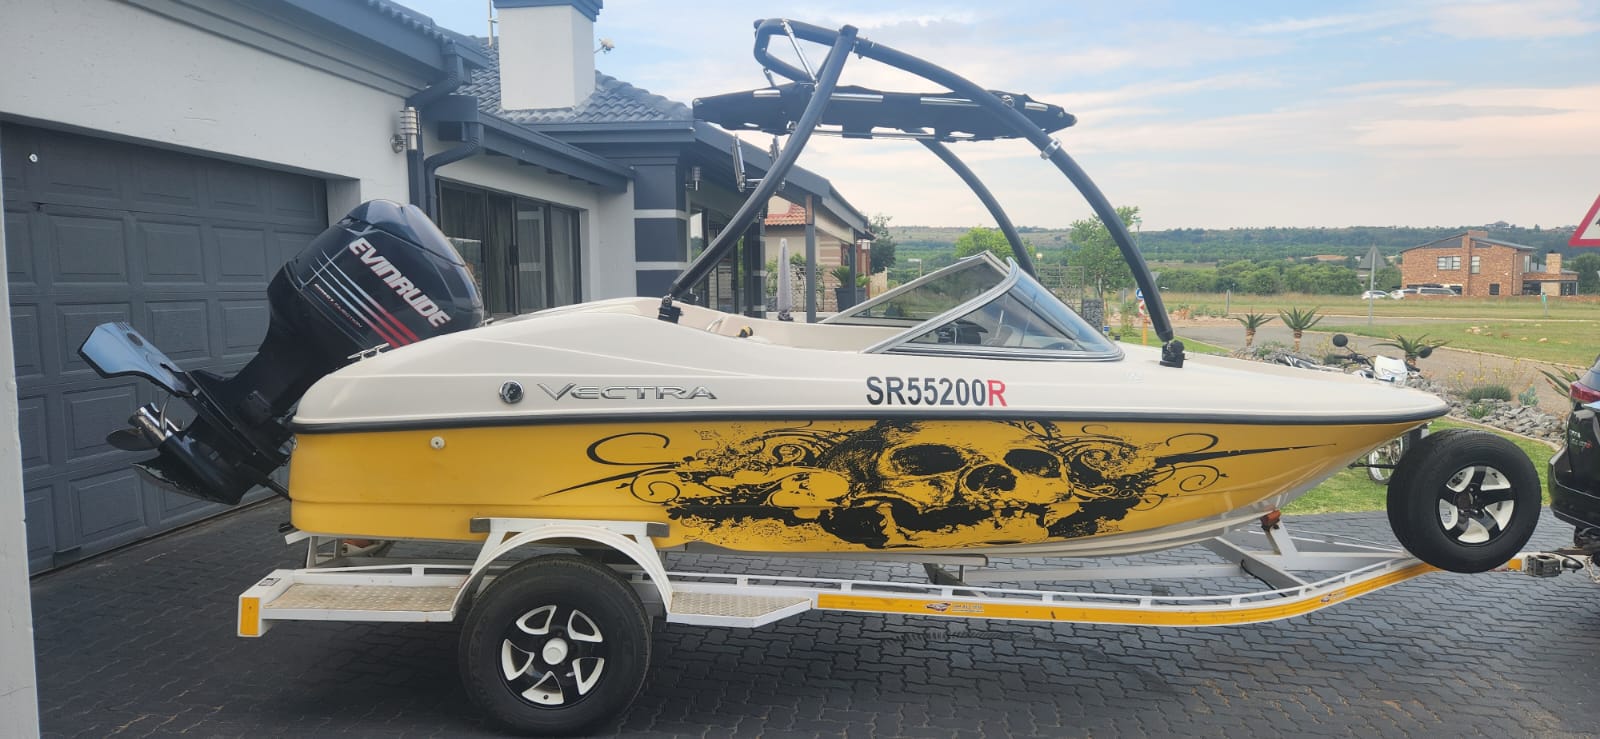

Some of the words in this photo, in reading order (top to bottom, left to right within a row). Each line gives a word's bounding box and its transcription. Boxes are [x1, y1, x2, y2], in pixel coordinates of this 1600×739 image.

[349, 237, 451, 328] EVINRUDE
[537, 382, 717, 401] VECTRA
[866, 376, 1008, 407] SR55200R
